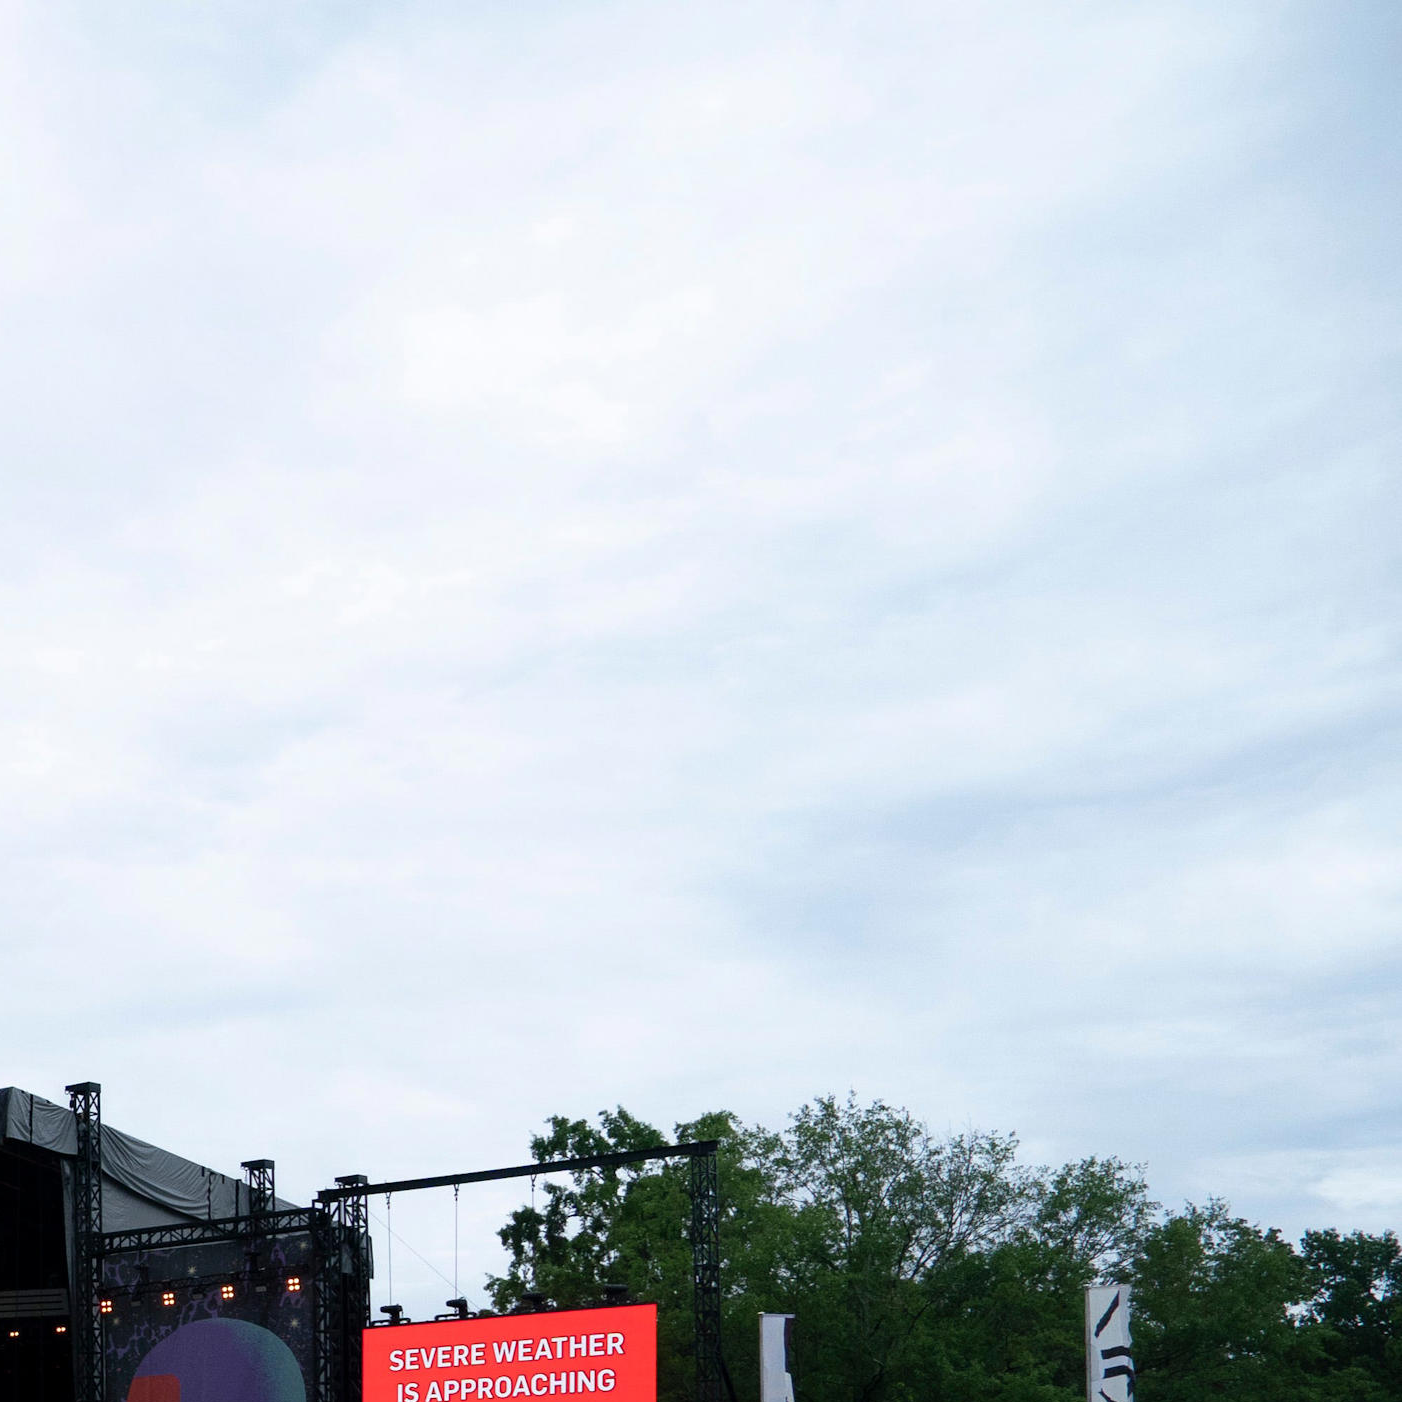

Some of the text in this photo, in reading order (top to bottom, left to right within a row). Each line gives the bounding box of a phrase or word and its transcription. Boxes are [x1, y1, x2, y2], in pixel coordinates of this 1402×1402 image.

[389, 1332, 624, 1372] SEVERE WEATHER
[425, 1368, 615, 1402] APPROACHING
